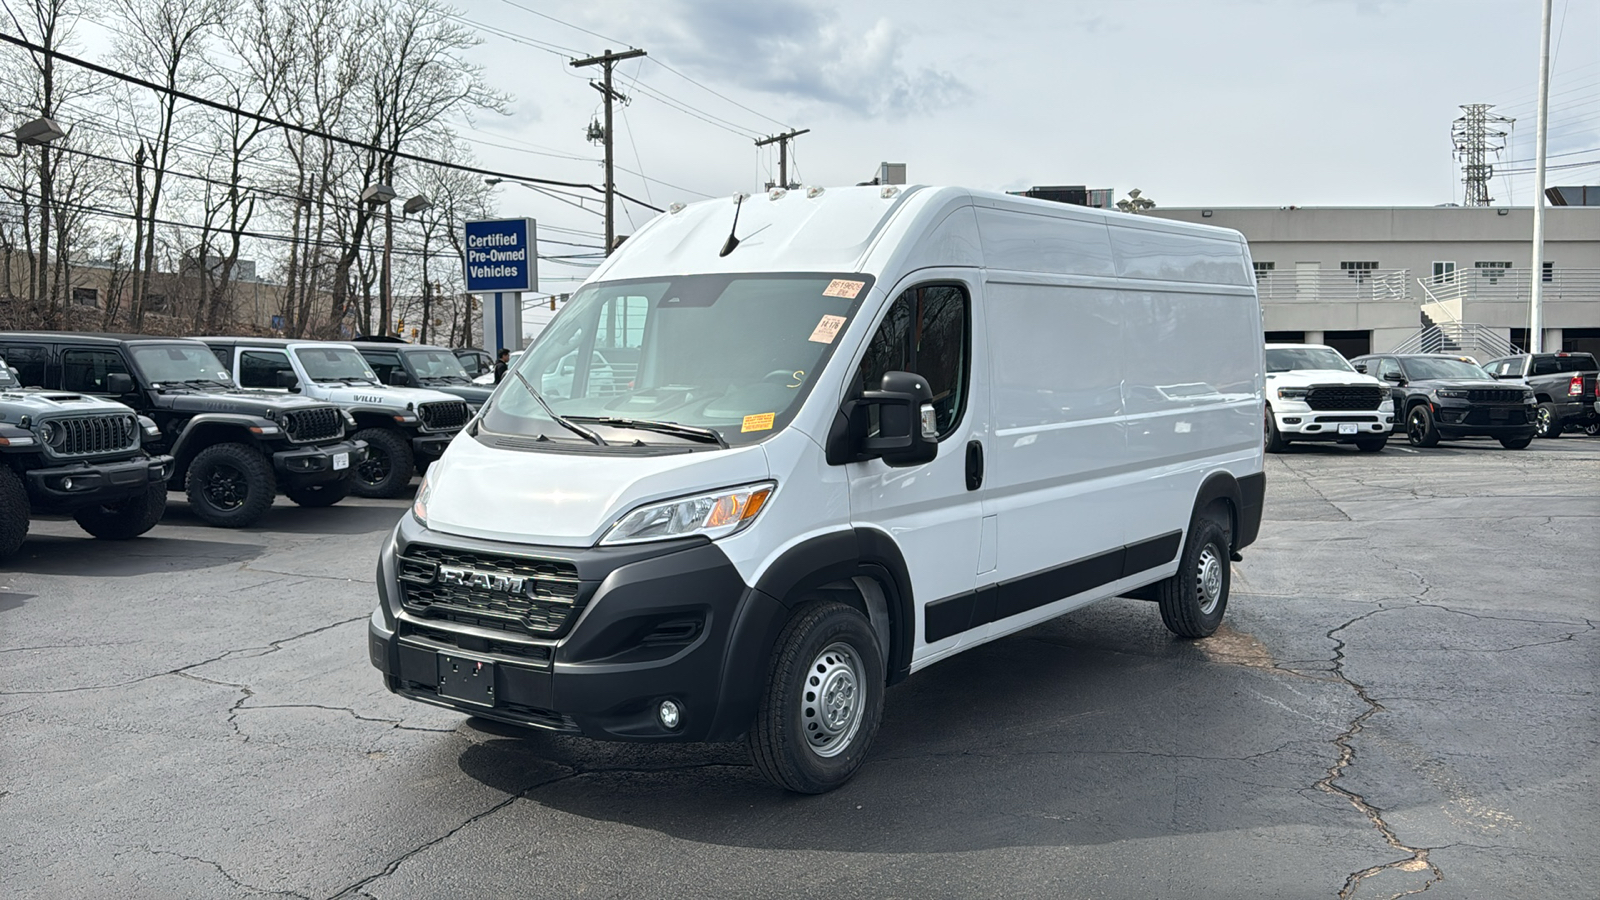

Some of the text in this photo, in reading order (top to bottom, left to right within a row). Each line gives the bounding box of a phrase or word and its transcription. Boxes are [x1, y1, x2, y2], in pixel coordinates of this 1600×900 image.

[468, 233, 517, 247] Certified
[469, 248, 525, 262] Pre-Owned
[470, 264, 518, 278] Vehicles
[353, 394, 384, 404] WILLYS
[438, 565, 524, 593] RAM
